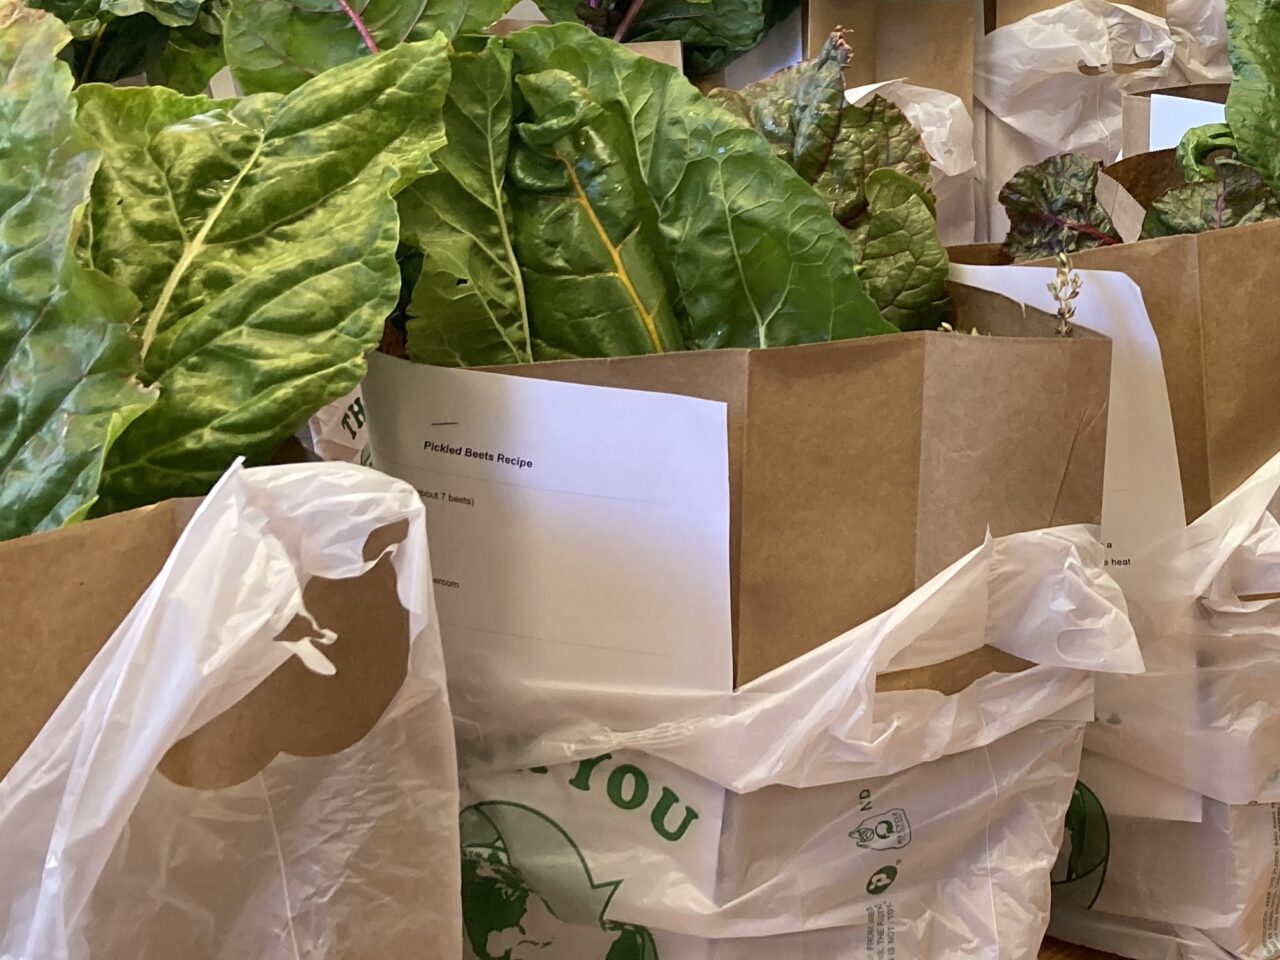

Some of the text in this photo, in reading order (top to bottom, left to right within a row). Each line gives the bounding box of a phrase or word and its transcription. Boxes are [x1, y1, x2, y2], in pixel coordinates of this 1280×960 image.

[423, 441, 533, 468] Pickled Beets Recipe
[448, 494, 475, 507] beets)
[1111, 558, 1131, 566] heat
[568, 753, 700, 842] YOU
[866, 926, 874, 951] FROM
[877, 928, 885, 946] THE
[887, 926, 895, 944] NOT
